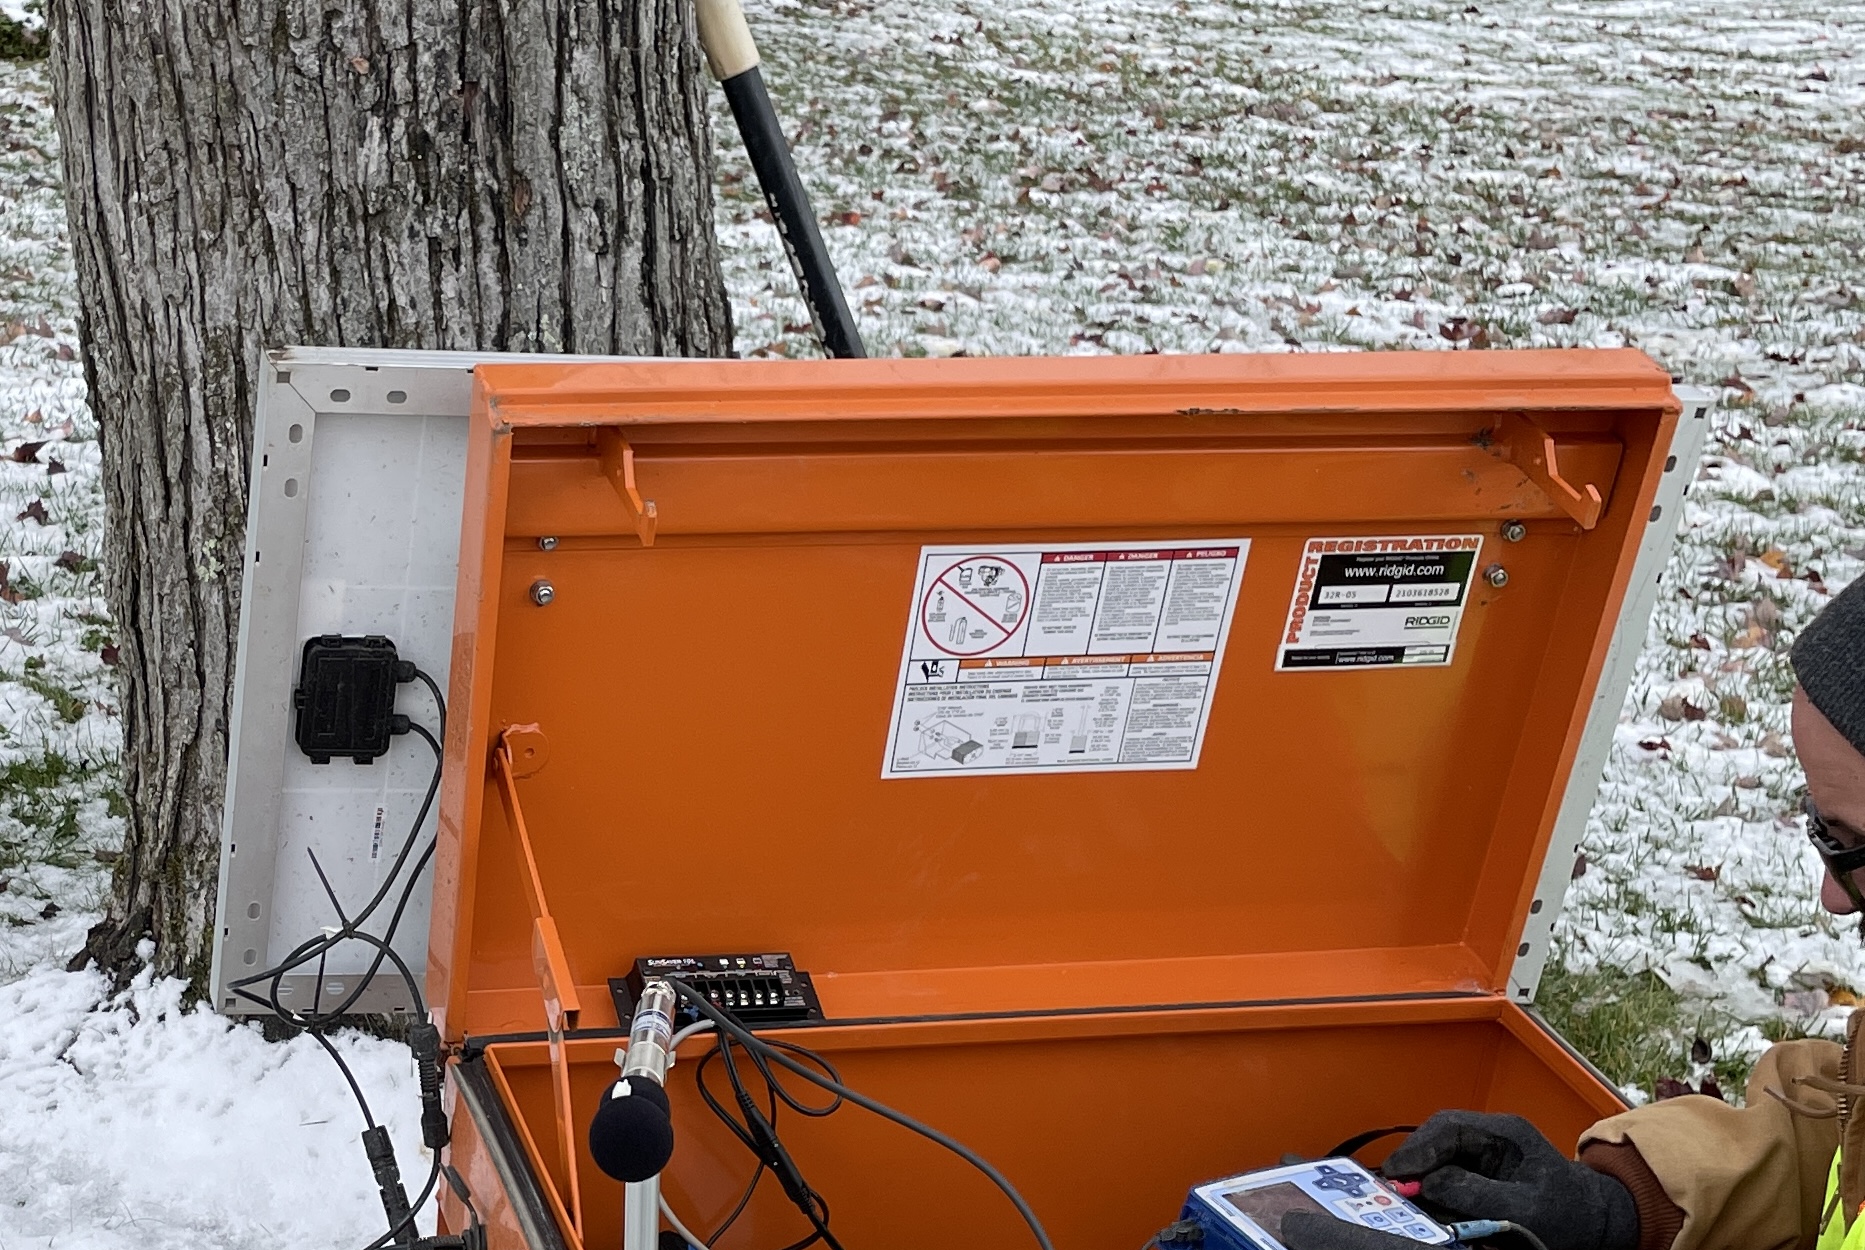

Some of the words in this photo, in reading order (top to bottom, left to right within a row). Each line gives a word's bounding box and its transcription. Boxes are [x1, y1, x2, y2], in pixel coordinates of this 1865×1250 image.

[1308, 537, 1479, 554] REGISTRATION
[1063, 554, 1094, 562] DANGER
[1127, 552, 1159, 560] DANGER
[1195, 550, 1227, 558] PELIGRO
[1345, 564, 1445, 579] www.ridgid.com
[1286, 556, 1320, 644] PRODUCT
[1404, 615, 1451, 626] RIDGID
